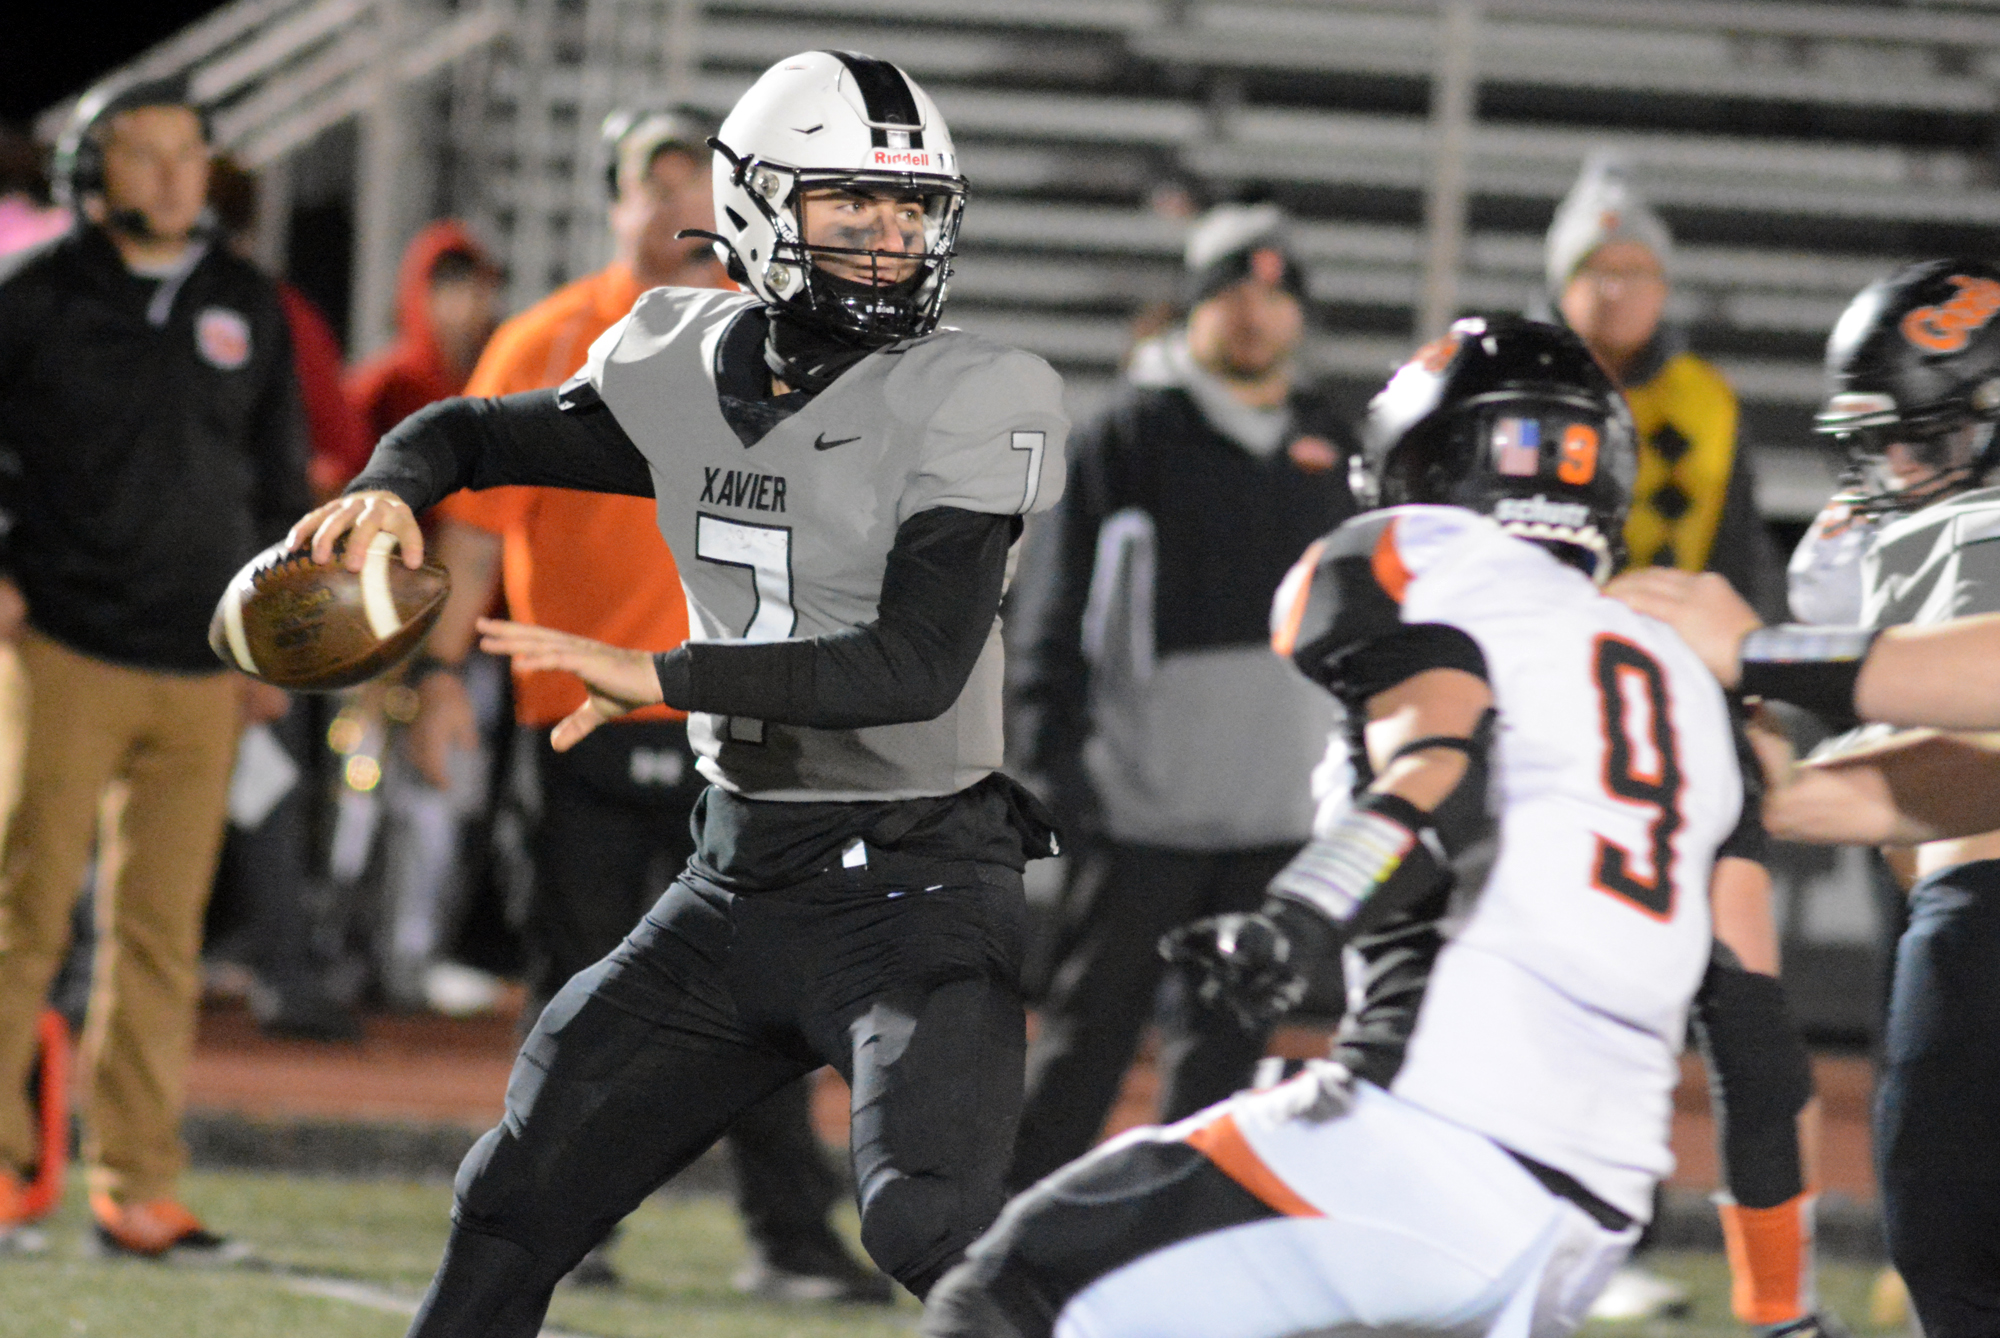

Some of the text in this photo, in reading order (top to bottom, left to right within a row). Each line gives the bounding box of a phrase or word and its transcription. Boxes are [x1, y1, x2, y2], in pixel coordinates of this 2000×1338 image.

[874, 151, 929, 166] Riddell
[700, 466, 787, 512] XAVIER
[1011, 431, 1046, 514] 7
[1558, 423, 1599, 486] 9
[696, 510, 798, 746] 7
[1589, 632, 1689, 924] 9
